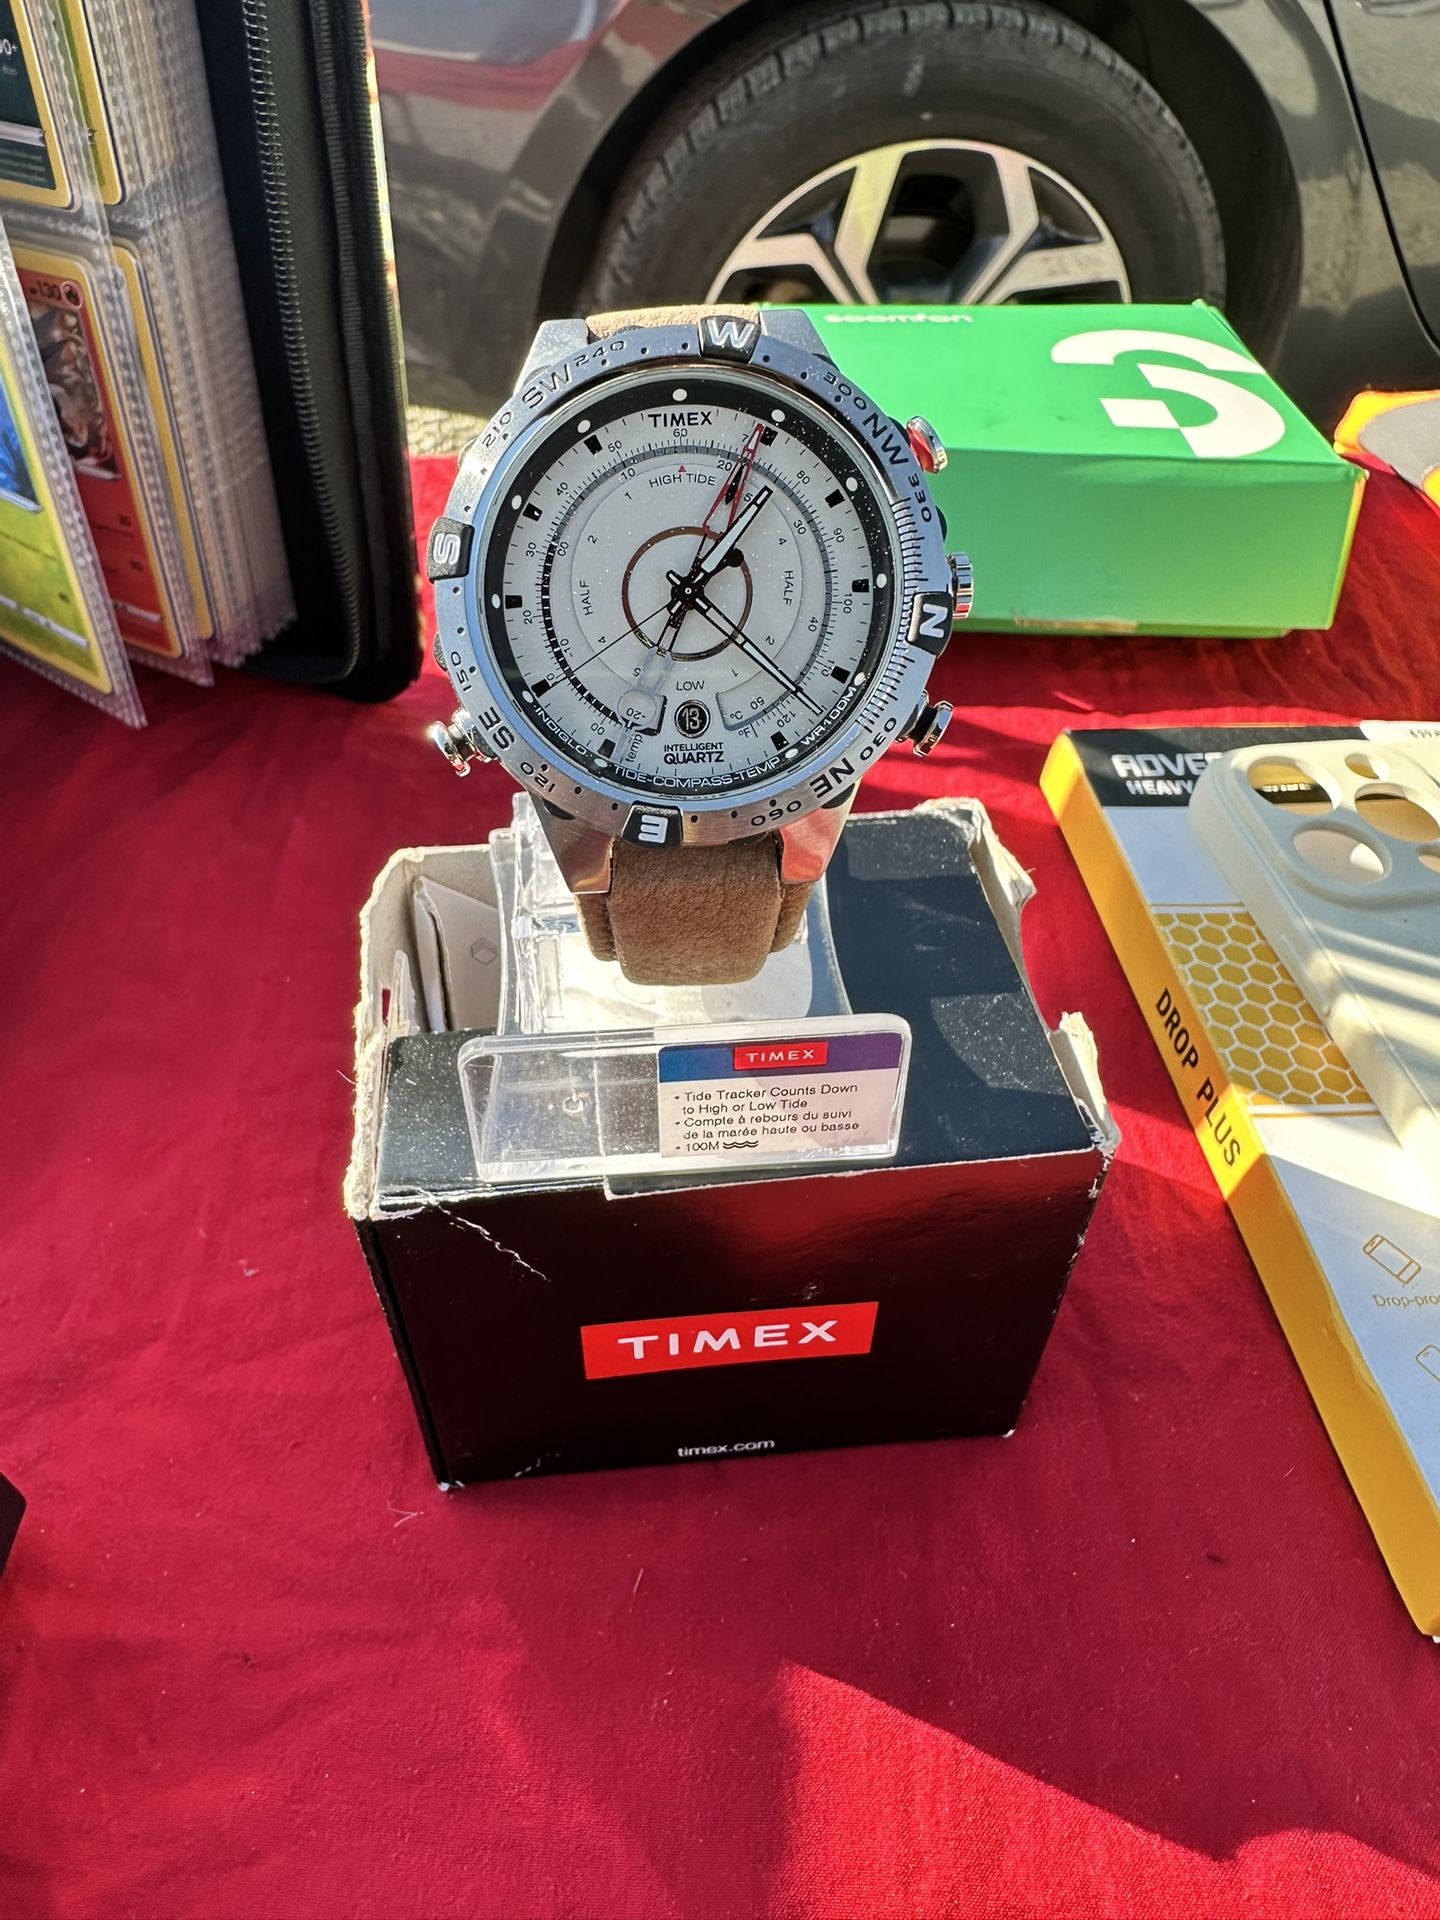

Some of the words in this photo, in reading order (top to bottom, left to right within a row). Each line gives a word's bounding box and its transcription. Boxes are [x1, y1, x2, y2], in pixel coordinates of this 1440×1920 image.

[707, 319, 755, 348] W
[574, 340, 626, 367] 240
[521, 363, 574, 410] SW
[823, 371, 867, 411] 300
[648, 411, 713, 428] TIMEX
[481, 411, 515, 449] 210
[673, 428, 688, 438] 60
[862, 412, 909, 466] NW
[607, 440, 622, 453] 50
[717, 459, 732, 472] 20
[649, 473, 682, 488] HIGH
[686, 473, 716, 486] TIDE
[796, 470, 811, 485] 80
[556, 482, 569, 496] 40
[624, 491, 632, 500] 1
[908, 473, 933, 523] 330
[793, 519, 807, 535] 30
[833, 527, 845, 543] 90
[587, 534, 597, 544] 2
[779, 537, 787, 545] 4
[433, 532, 461, 565] S
[525, 542, 537, 557] 30
[782, 569, 794, 607] HALF
[580, 580, 593, 616] HALF
[843, 592, 853, 614] 100
[523, 610, 533, 624] 20
[808, 616, 820, 632] 40
[919, 603, 949, 638] N
[766, 636, 775, 646] 2
[451, 651, 473, 692] 150
[632, 667, 641, 677] 5
[676, 680, 705, 691] LOW
[750, 696, 765, 710] 50
[682, 707, 701, 731] 13
[777, 710, 797, 728] 120
[478, 707, 516, 751] SE
[535, 707, 587, 755] INDIGLO
[591, 722, 605, 735] 00
[664, 742, 724, 752] INTELLIGENT
[860, 717, 898, 761] 030
[626, 734, 644, 763] temp
[664, 751, 724, 764] QUARTZ
[520, 761, 556, 793] 120
[614, 756, 781, 788] TIDE-COMPASS-TEMP
[809, 757, 856, 799] NE
[1126, 779, 1194, 796] HEAVY
[751, 800, 802, 827] 090
[638, 815, 669, 844] E
[746, 1049, 815, 1062] TIMEX
[1156, 987, 1199, 1069] DROP
[1196, 1076, 1241, 1167] PLUS
[685, 1092, 711, 1101] Tide
[716, 1088, 766, 1100] Tracker
[770, 1086, 816, 1097] Counts
[821, 1083, 858, 1094] Down
[683, 1106, 694, 1115] to
[699, 1103, 728, 1116] High
[732, 1104, 745, 1112] or
[749, 1101, 776, 1111] Low
[780, 1099, 808, 1109] Tide
[684, 1116, 733, 1130] Compte
[738, 1114, 746, 1124] à
[751, 1112, 798, 1124] rebours
[803, 1110, 818, 1120] du
[823, 1110, 851, 1119] suivi
[684, 1130, 698, 1140] de
[702, 1129, 713, 1138] la
[718, 1125, 757, 1137] marée
[762, 1125, 796, 1135] haute
[801, 1123, 816, 1132] ou
[821, 1121, 859, 1131] basse
[686, 1141, 719, 1151] 100M
[617, 1319, 838, 1360] TIMEX
[677, 1438, 775, 1457] timex.com
